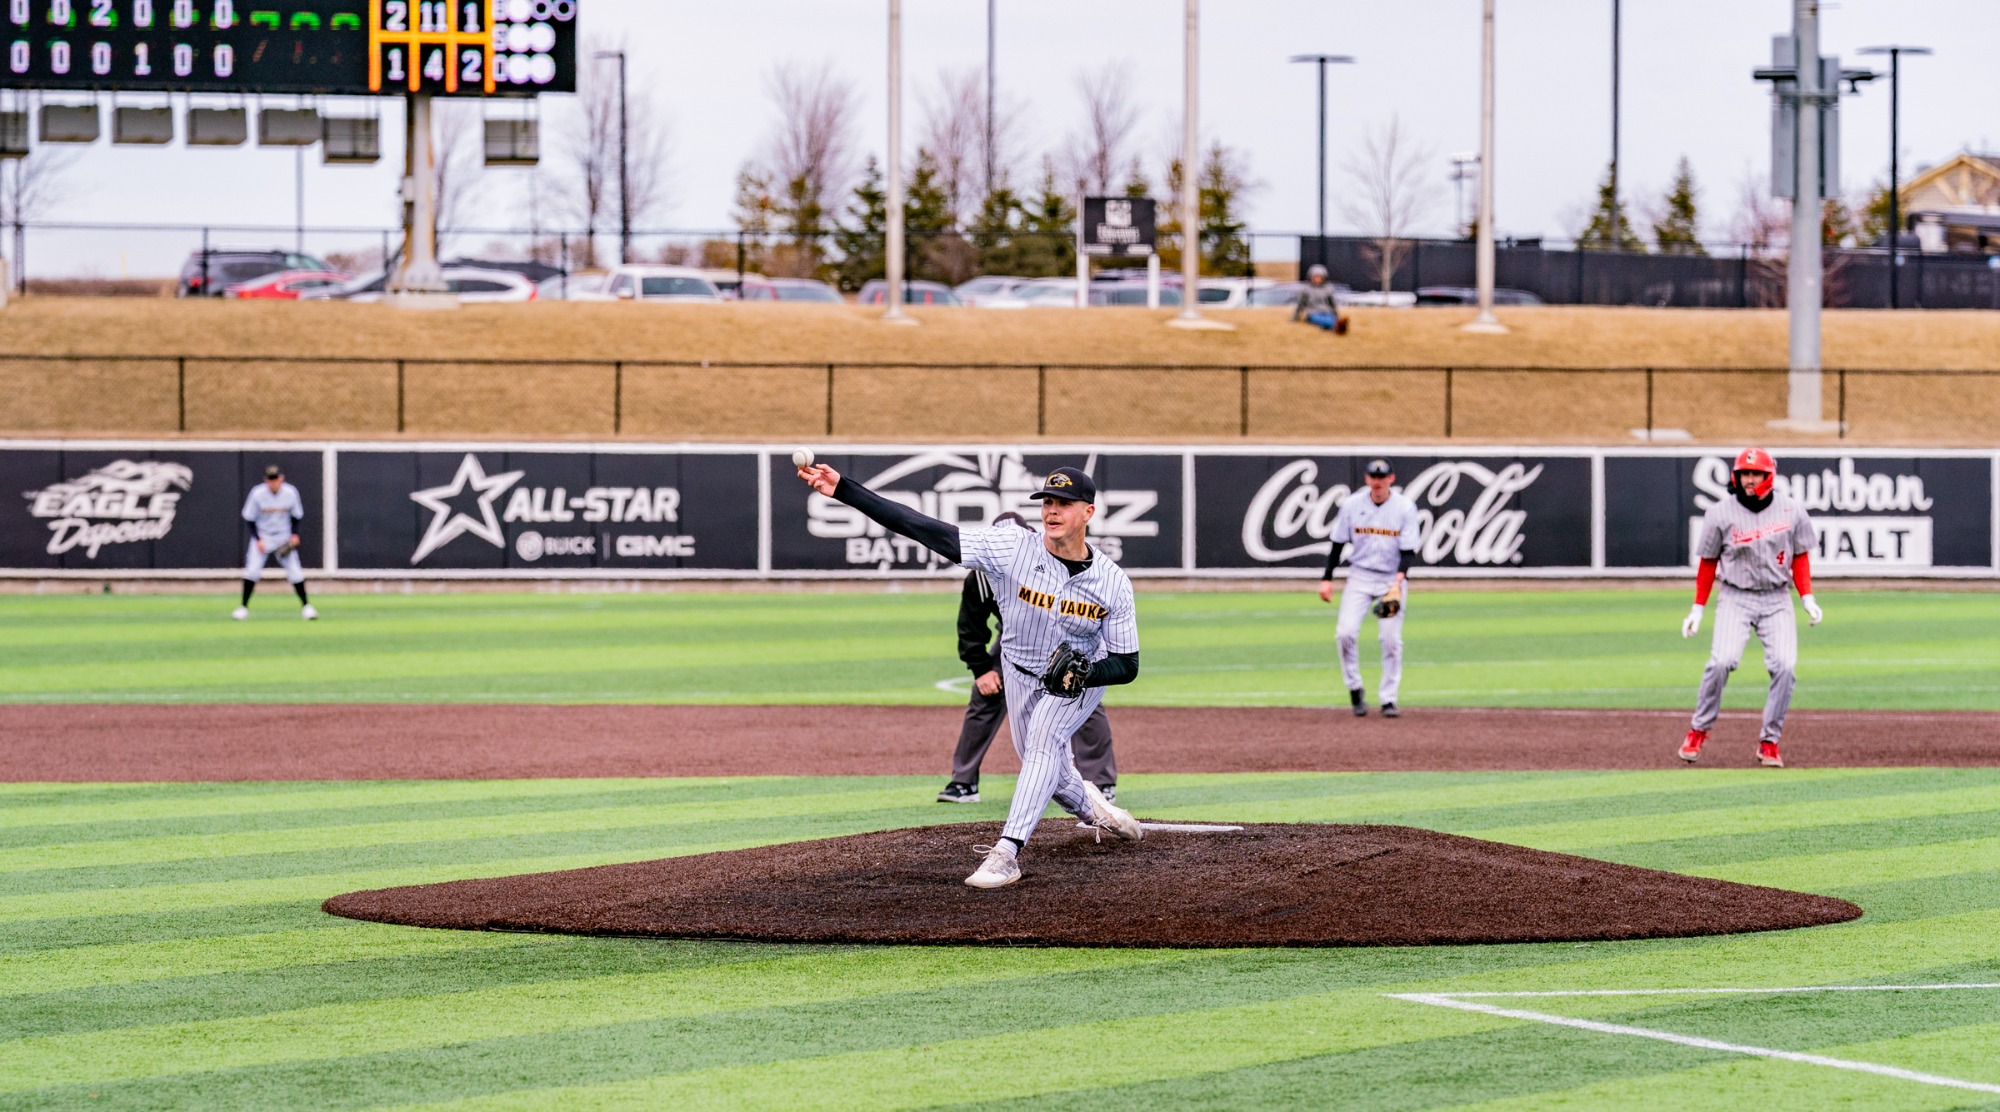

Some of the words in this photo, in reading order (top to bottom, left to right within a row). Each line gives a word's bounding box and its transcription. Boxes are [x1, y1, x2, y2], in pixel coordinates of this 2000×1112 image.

[10, 0, 30, 25] 0
[52, 0, 71, 26] 0
[91, 0, 112, 27] 2
[134, 0, 153, 27] 0
[174, 0, 193, 28] 0
[214, 0, 233, 29] 0
[386, 1, 407, 31] 2
[420, 1, 448, 33] 11
[464, 2, 480, 33] 1
[10, 40, 30, 73] 0
[51, 41, 71, 74] 0
[92, 41, 112, 75] 0
[134, 42, 152, 75] 1
[174, 43, 193, 76] 0
[214, 43, 234, 77] 0
[387, 48, 405, 81] 1
[424, 48, 444, 81] 4
[461, 50, 482, 82] 2
[32, 492, 181, 518] EAGLE
[503, 487, 680, 523] ALL-STAR
[544, 536, 596, 555] BUICK
[616, 535, 696, 557] GMC
[1776, 550, 1785, 566] 4
